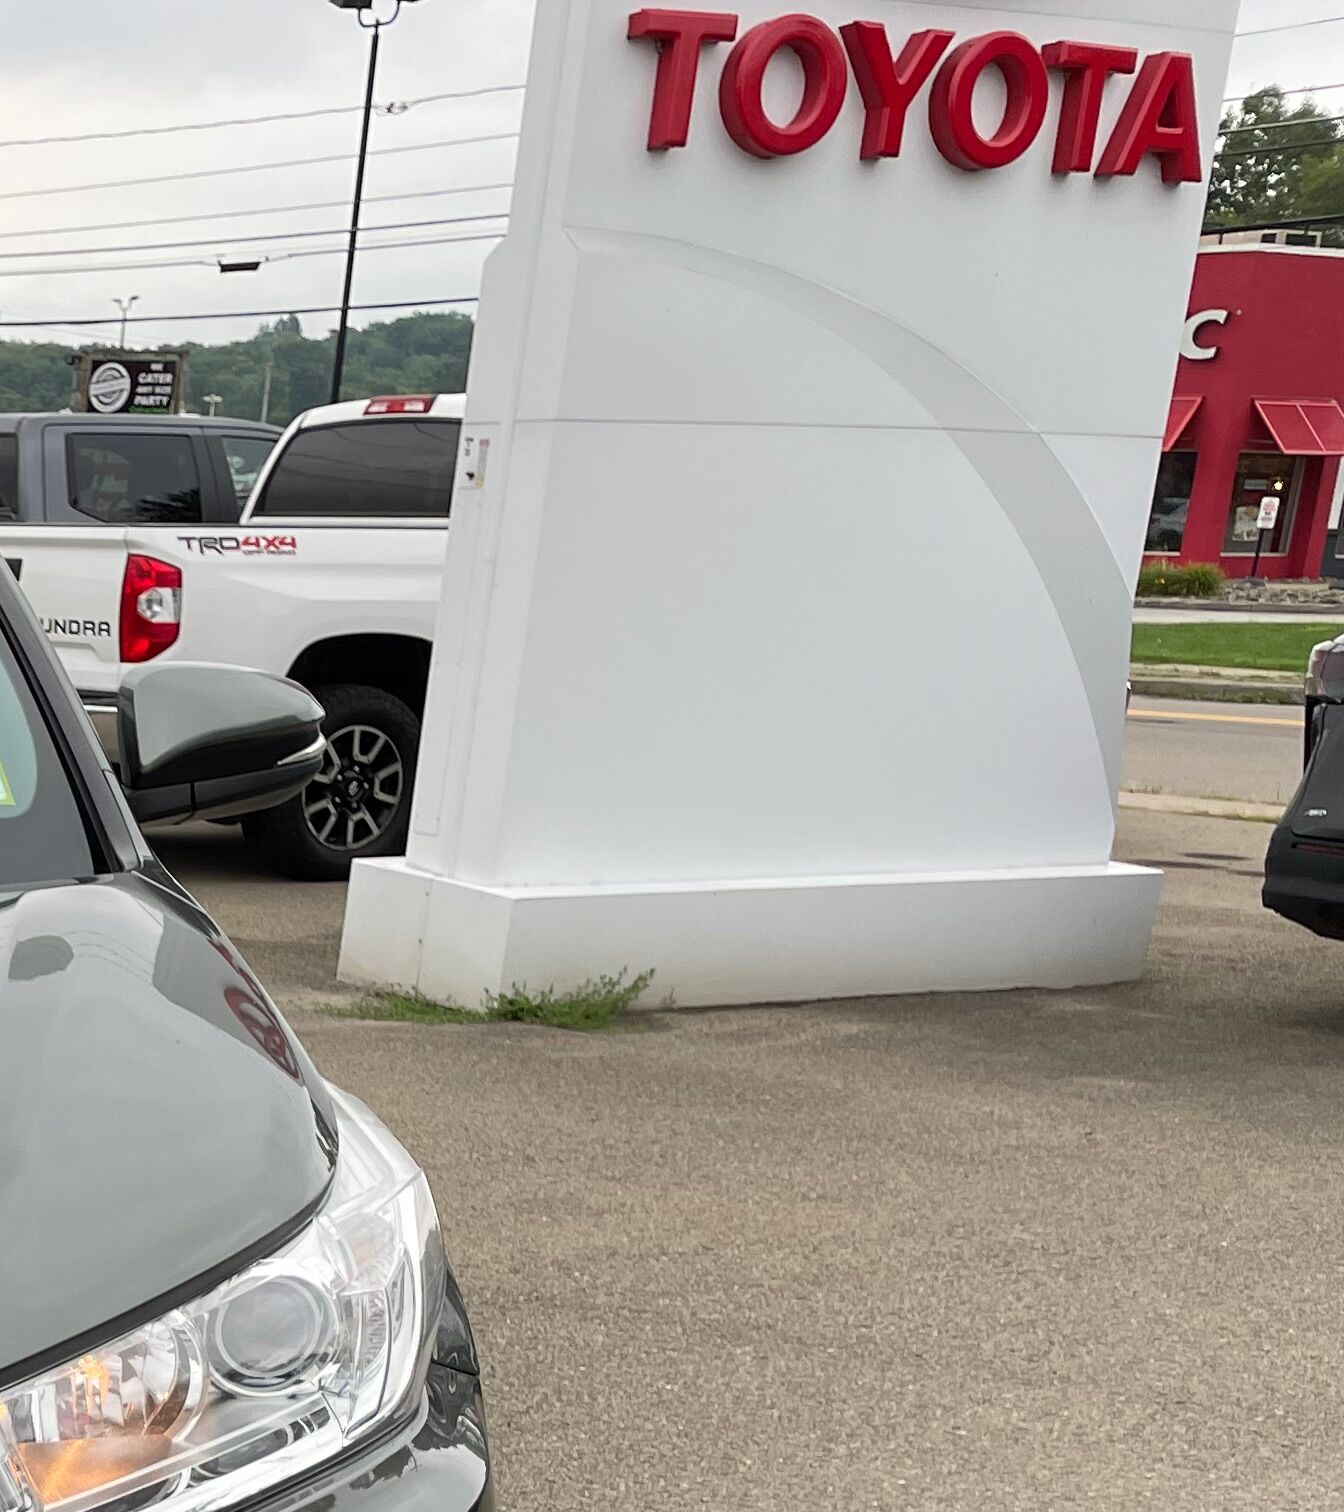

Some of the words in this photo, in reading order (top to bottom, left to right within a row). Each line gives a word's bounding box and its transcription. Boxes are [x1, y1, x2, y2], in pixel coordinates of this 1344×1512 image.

[627, 8, 1204, 185] TOYOTA
[1179, 308, 1229, 360] C
[40, 618, 111, 637] UNDRA
